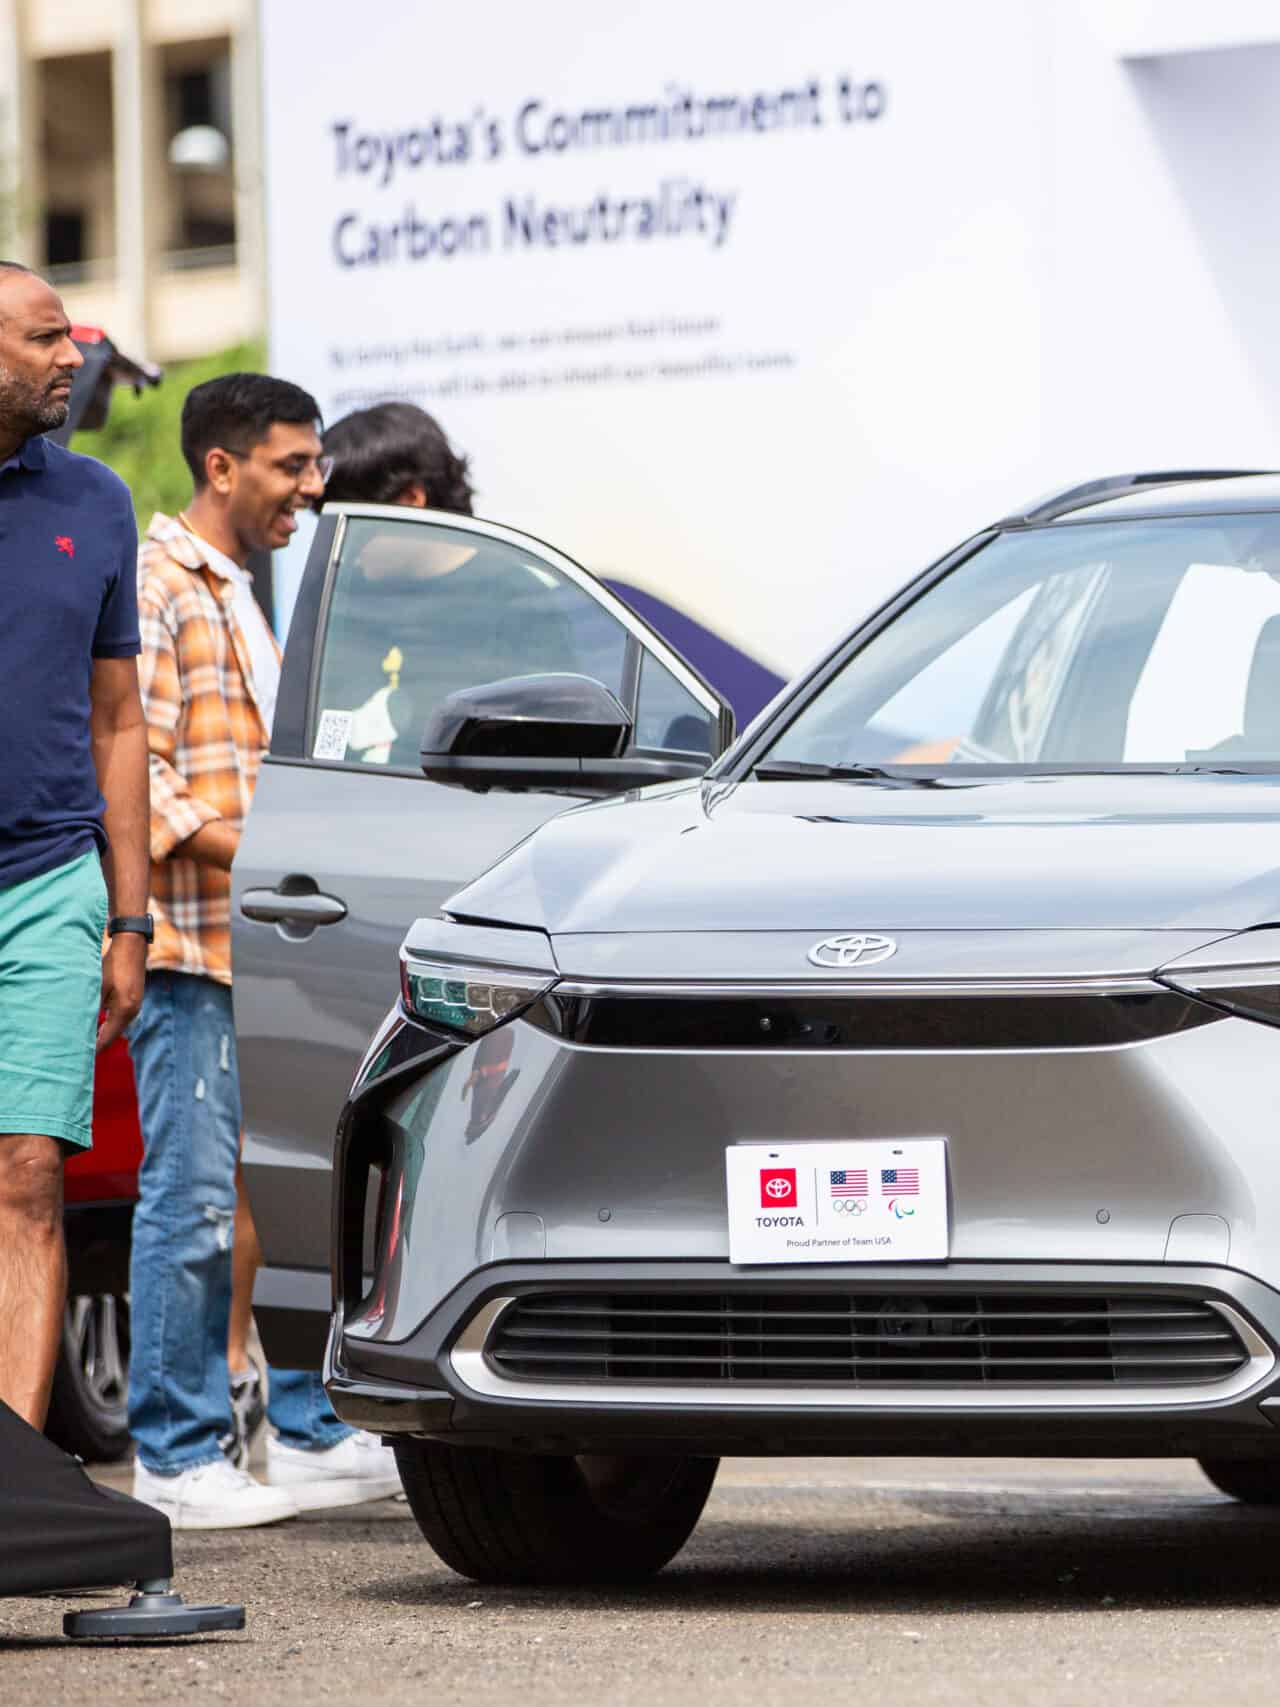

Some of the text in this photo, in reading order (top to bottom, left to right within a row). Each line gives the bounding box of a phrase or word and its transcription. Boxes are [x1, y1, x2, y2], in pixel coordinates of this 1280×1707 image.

[332, 72, 888, 187] Toyota's Commitment to
[332, 178, 735, 268] Carbon Neutrality
[756, 1216, 804, 1228] TOYOTA
[786, 1236, 891, 1248] Proud Partner of Team USA
